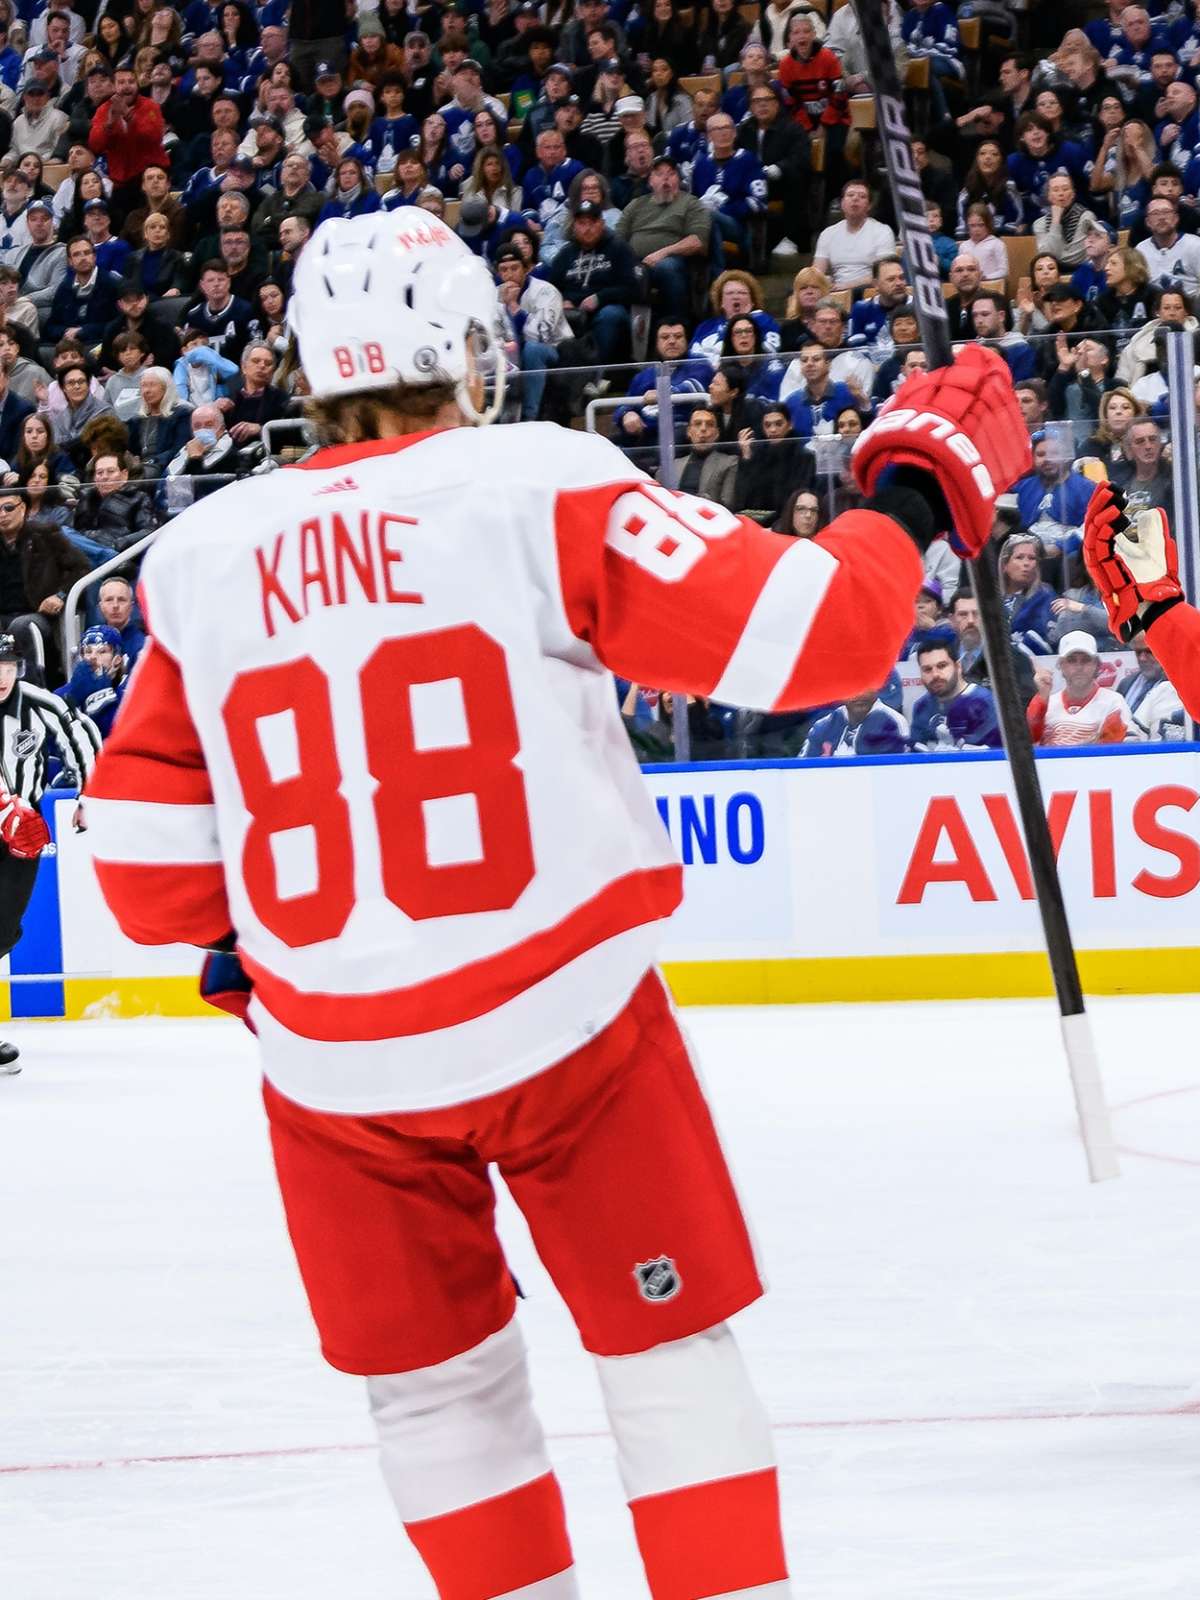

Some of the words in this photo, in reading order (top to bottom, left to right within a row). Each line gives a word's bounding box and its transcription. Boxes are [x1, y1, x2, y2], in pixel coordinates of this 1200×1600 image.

[333, 341, 385, 378] 88
[254, 509, 425, 637] KANE
[220, 621, 537, 949] 88
